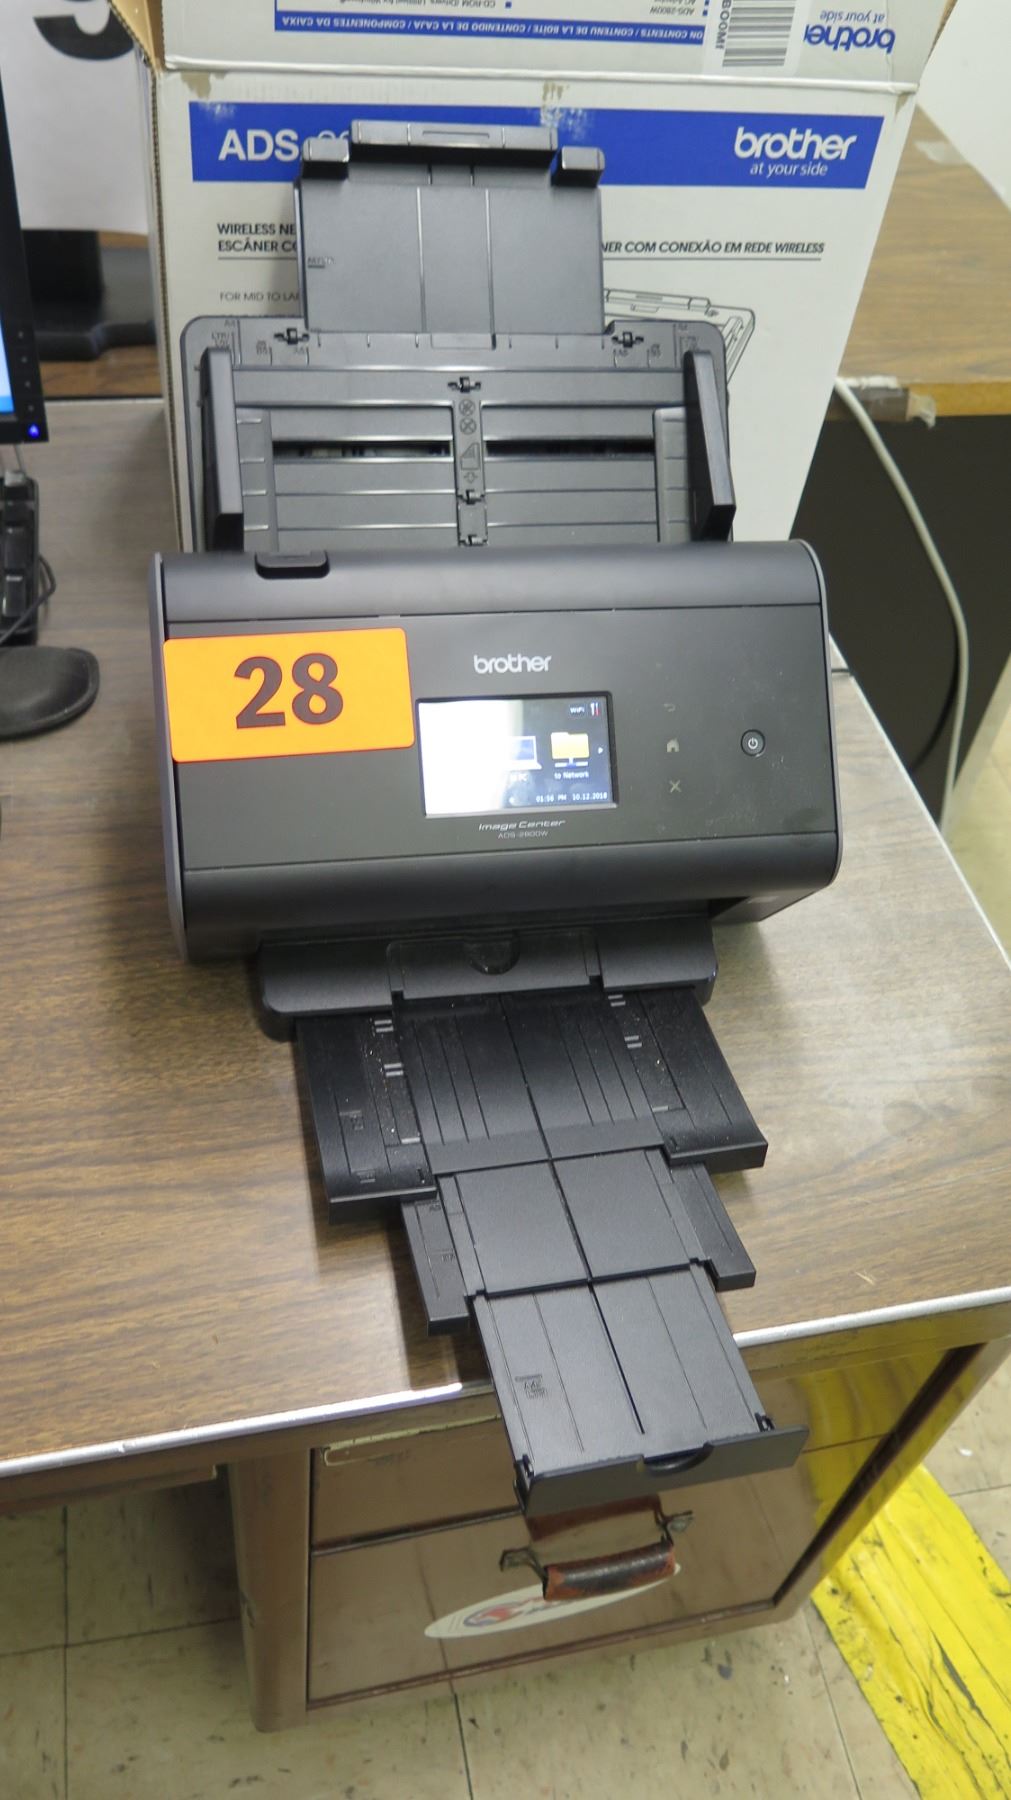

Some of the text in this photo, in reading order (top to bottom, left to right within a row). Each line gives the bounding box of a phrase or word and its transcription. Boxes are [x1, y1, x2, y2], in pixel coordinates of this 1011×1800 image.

[282, 16, 314, 27] CAIXA
[819, 9, 885, 24] at your side
[640, 28, 688, 39] CONTENTS
[734, 126, 858, 161] brother
[750, 161, 829, 179] at your side
[217, 222, 277, 236] WIRELESS
[624, 241, 657, 254] COM
[724, 241, 743, 254] EM
[744, 242, 773, 254] REDE
[774, 242, 826, 254] WIRELESS
[219, 291, 241, 302] FOR
[243, 291, 265, 302] MID
[267, 291, 281, 301] TO
[473, 653, 552, 675] brother
[234, 652, 344, 730] 28
[562, 770, 590, 780] Network
[557, 793, 568, 802] PM
[478, 820, 567, 832] Image Center
